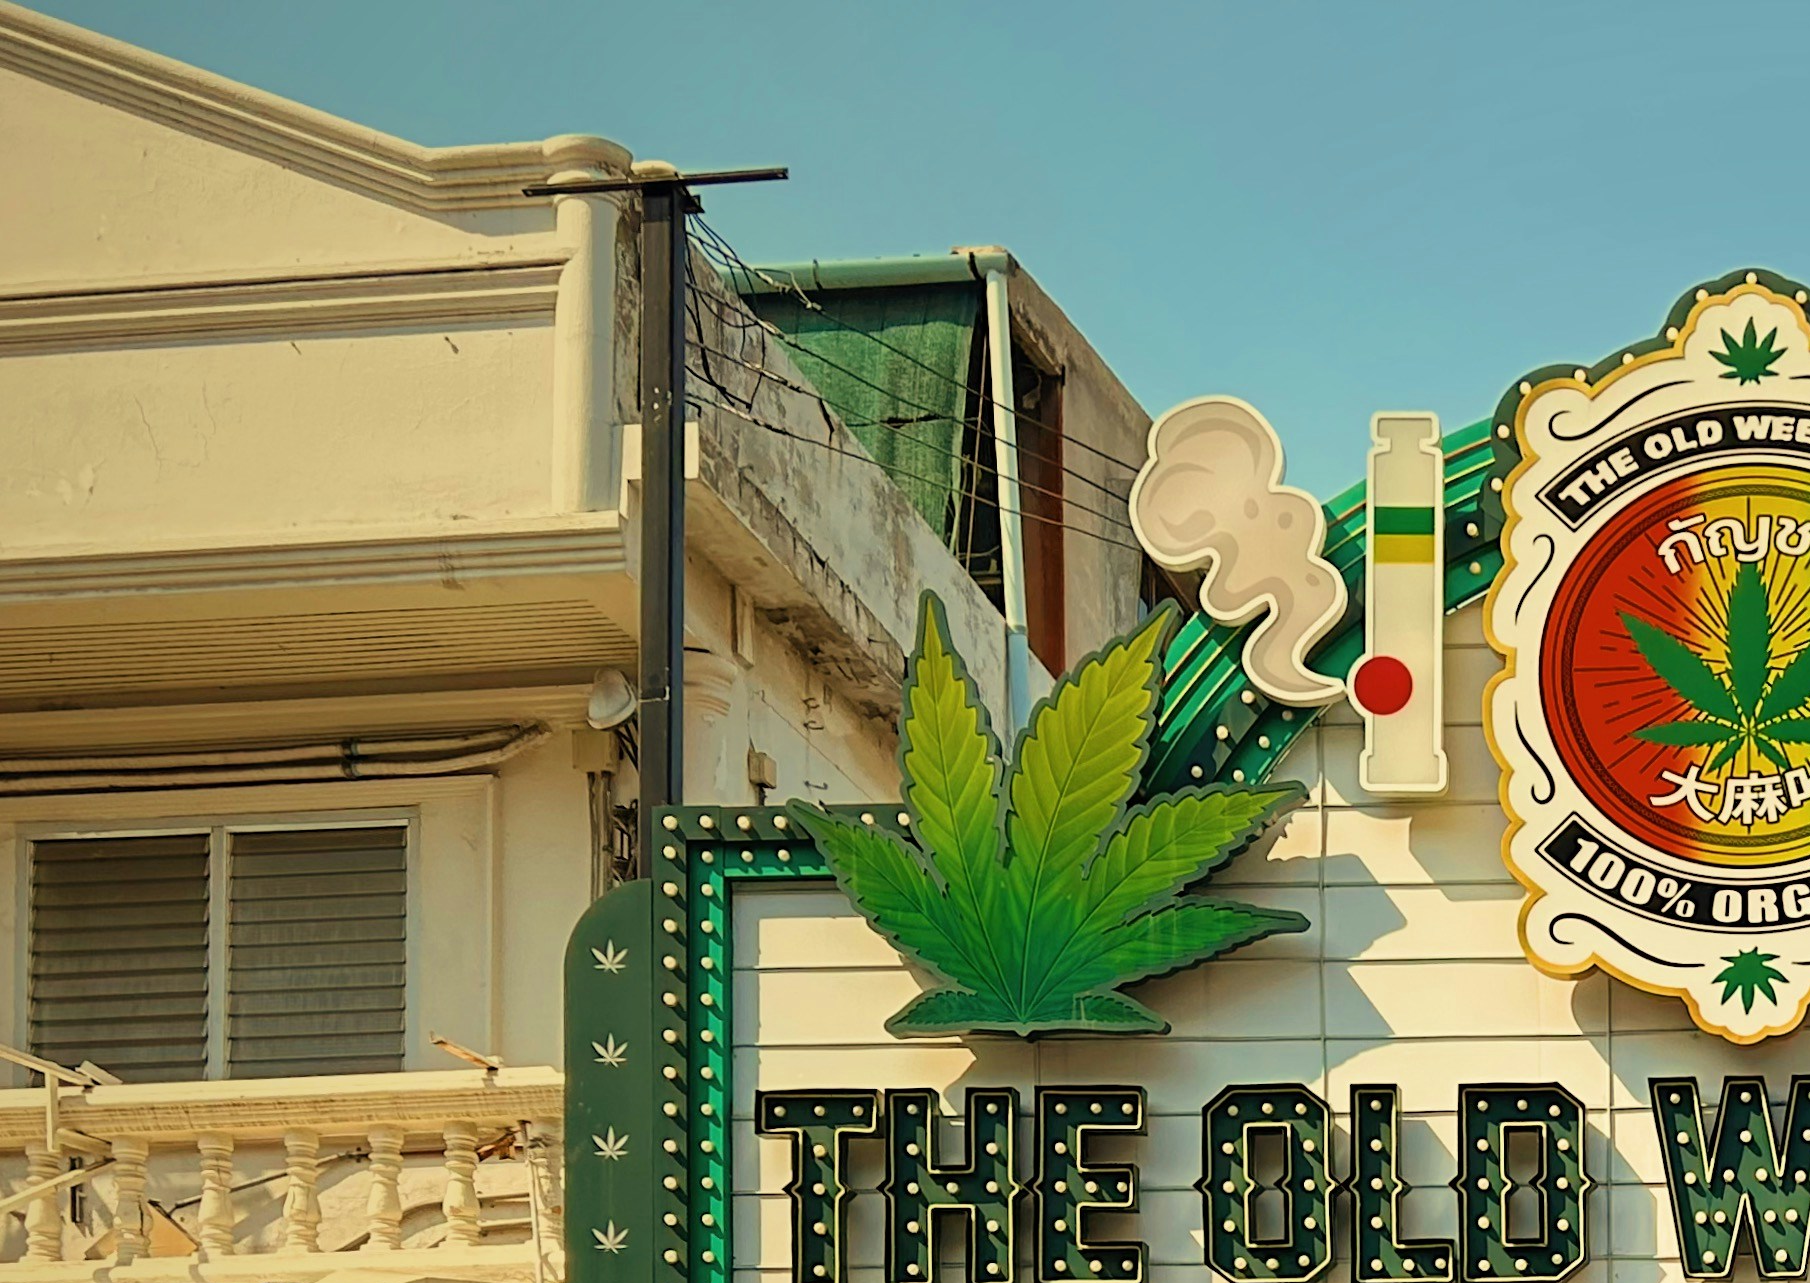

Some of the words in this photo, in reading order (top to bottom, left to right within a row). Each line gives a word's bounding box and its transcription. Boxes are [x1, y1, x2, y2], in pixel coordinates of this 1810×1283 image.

[1558, 446, 1640, 508] THE
[1643, 418, 1724, 461] OLD
[1567, 837, 1696, 919] 100%
